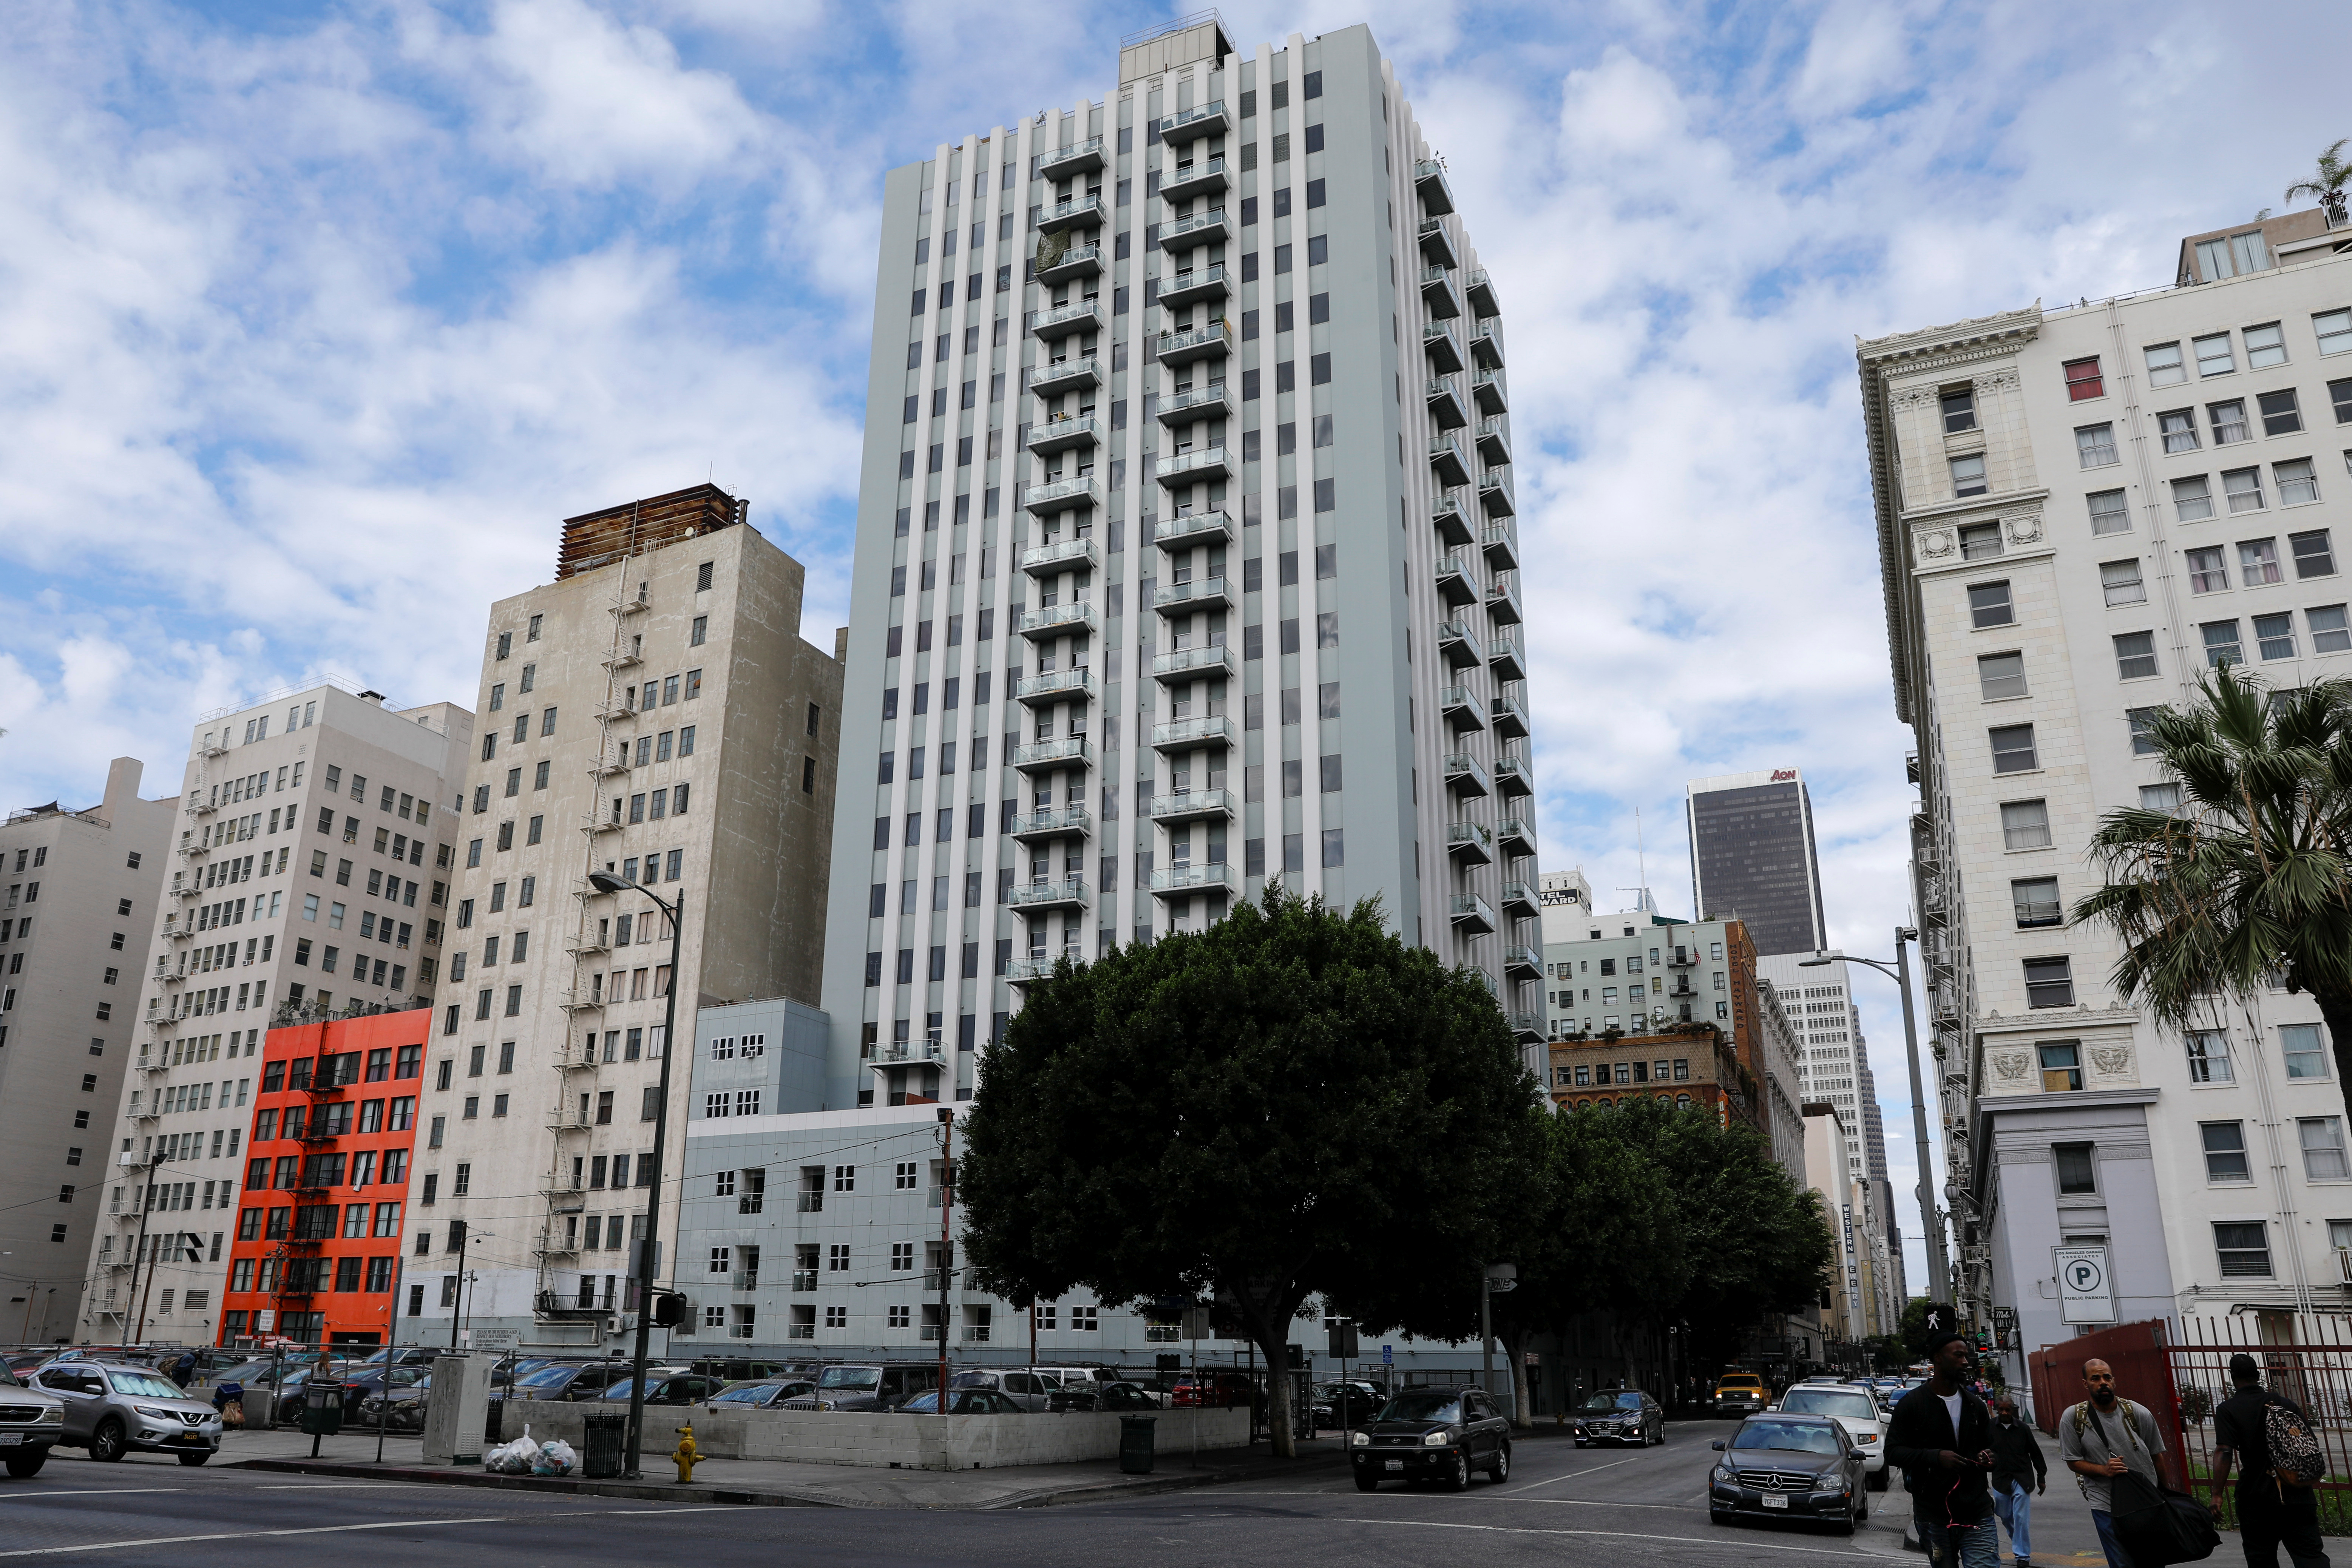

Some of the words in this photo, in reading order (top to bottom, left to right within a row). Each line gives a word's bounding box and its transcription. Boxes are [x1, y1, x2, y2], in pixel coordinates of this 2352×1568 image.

[1730, 945, 1739, 973] HOTEL
[1733, 981, 1744, 1028] HAYWARD
[1843, 1206, 1853, 1252] WESTERN
[2076, 1267, 2090, 1285] P
